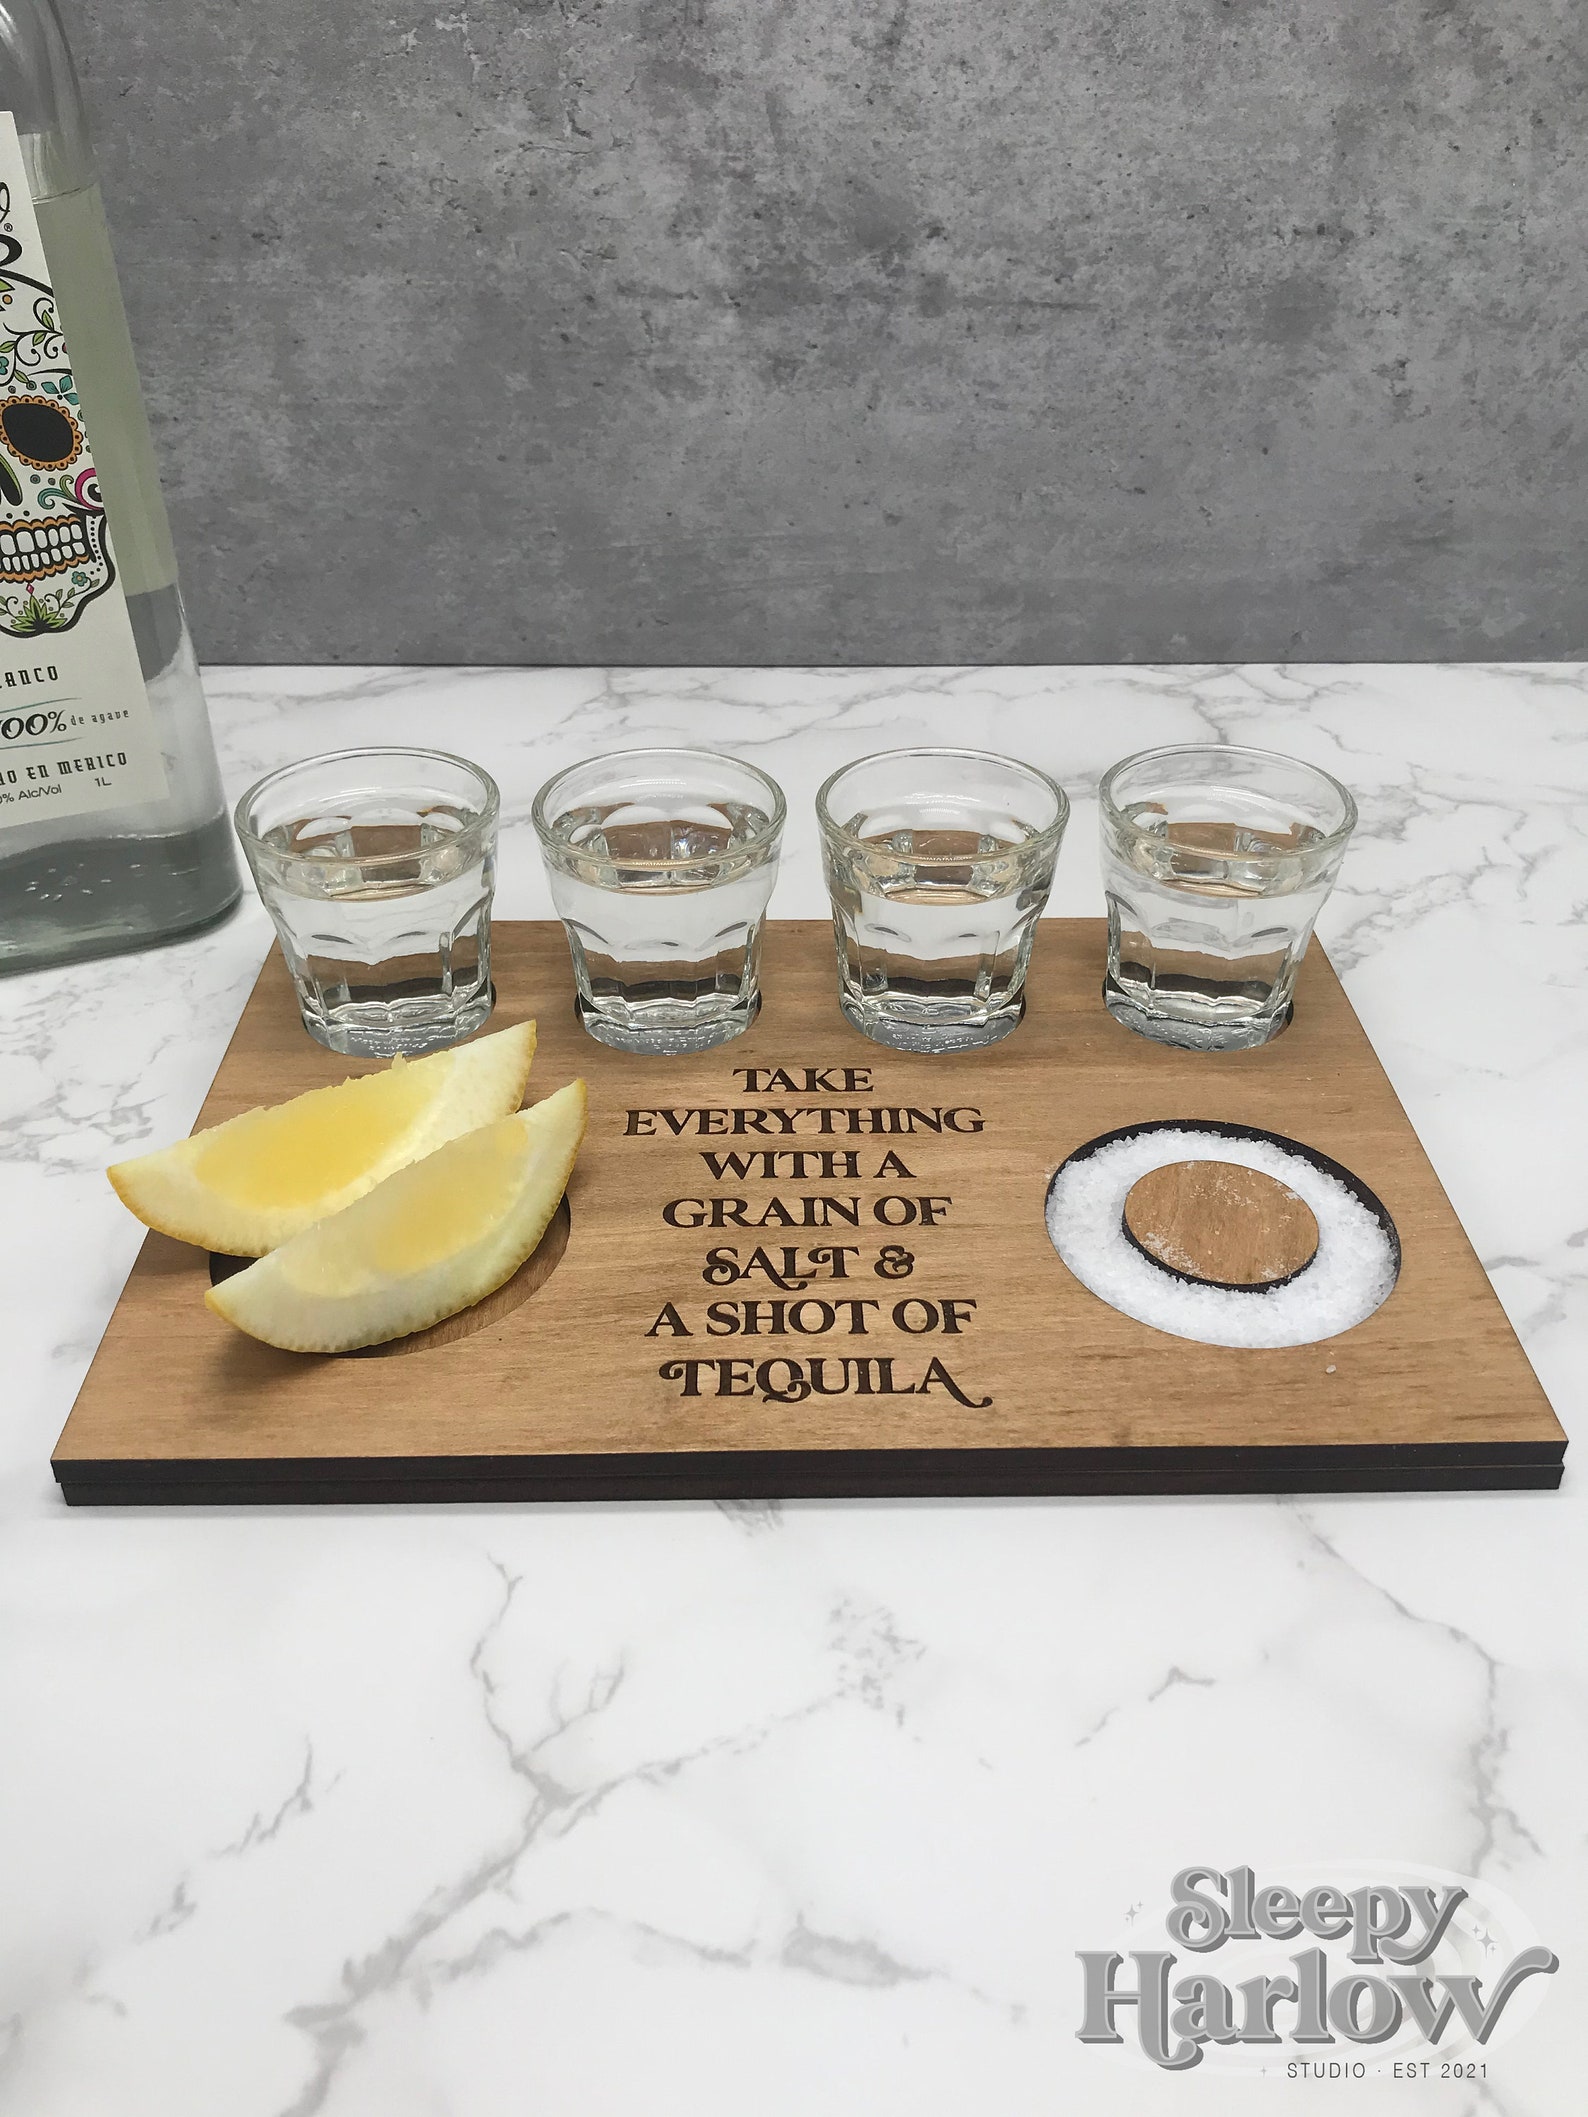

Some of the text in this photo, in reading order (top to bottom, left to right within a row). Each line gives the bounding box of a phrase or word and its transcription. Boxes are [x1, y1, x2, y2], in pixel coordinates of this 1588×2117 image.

[0, 665, 59, 689] ANCO
[0, 709, 130, 740] 00% de agave
[26, 764, 50, 780] EN
[94, 777, 112, 787] 1L
[18, 784, 62, 801] Alc/Vol
[732, 1067, 875, 1093] TAKE
[622, 1107, 986, 1136] EVERYTHING
[699, 1150, 917, 1180] WITH A
[662, 1195, 953, 1228] GRAIN OF
[701, 1244, 915, 1291] SALT &
[644, 1298, 978, 1337] A SHOT OF
[658, 1355, 994, 1409] TEQUILA
